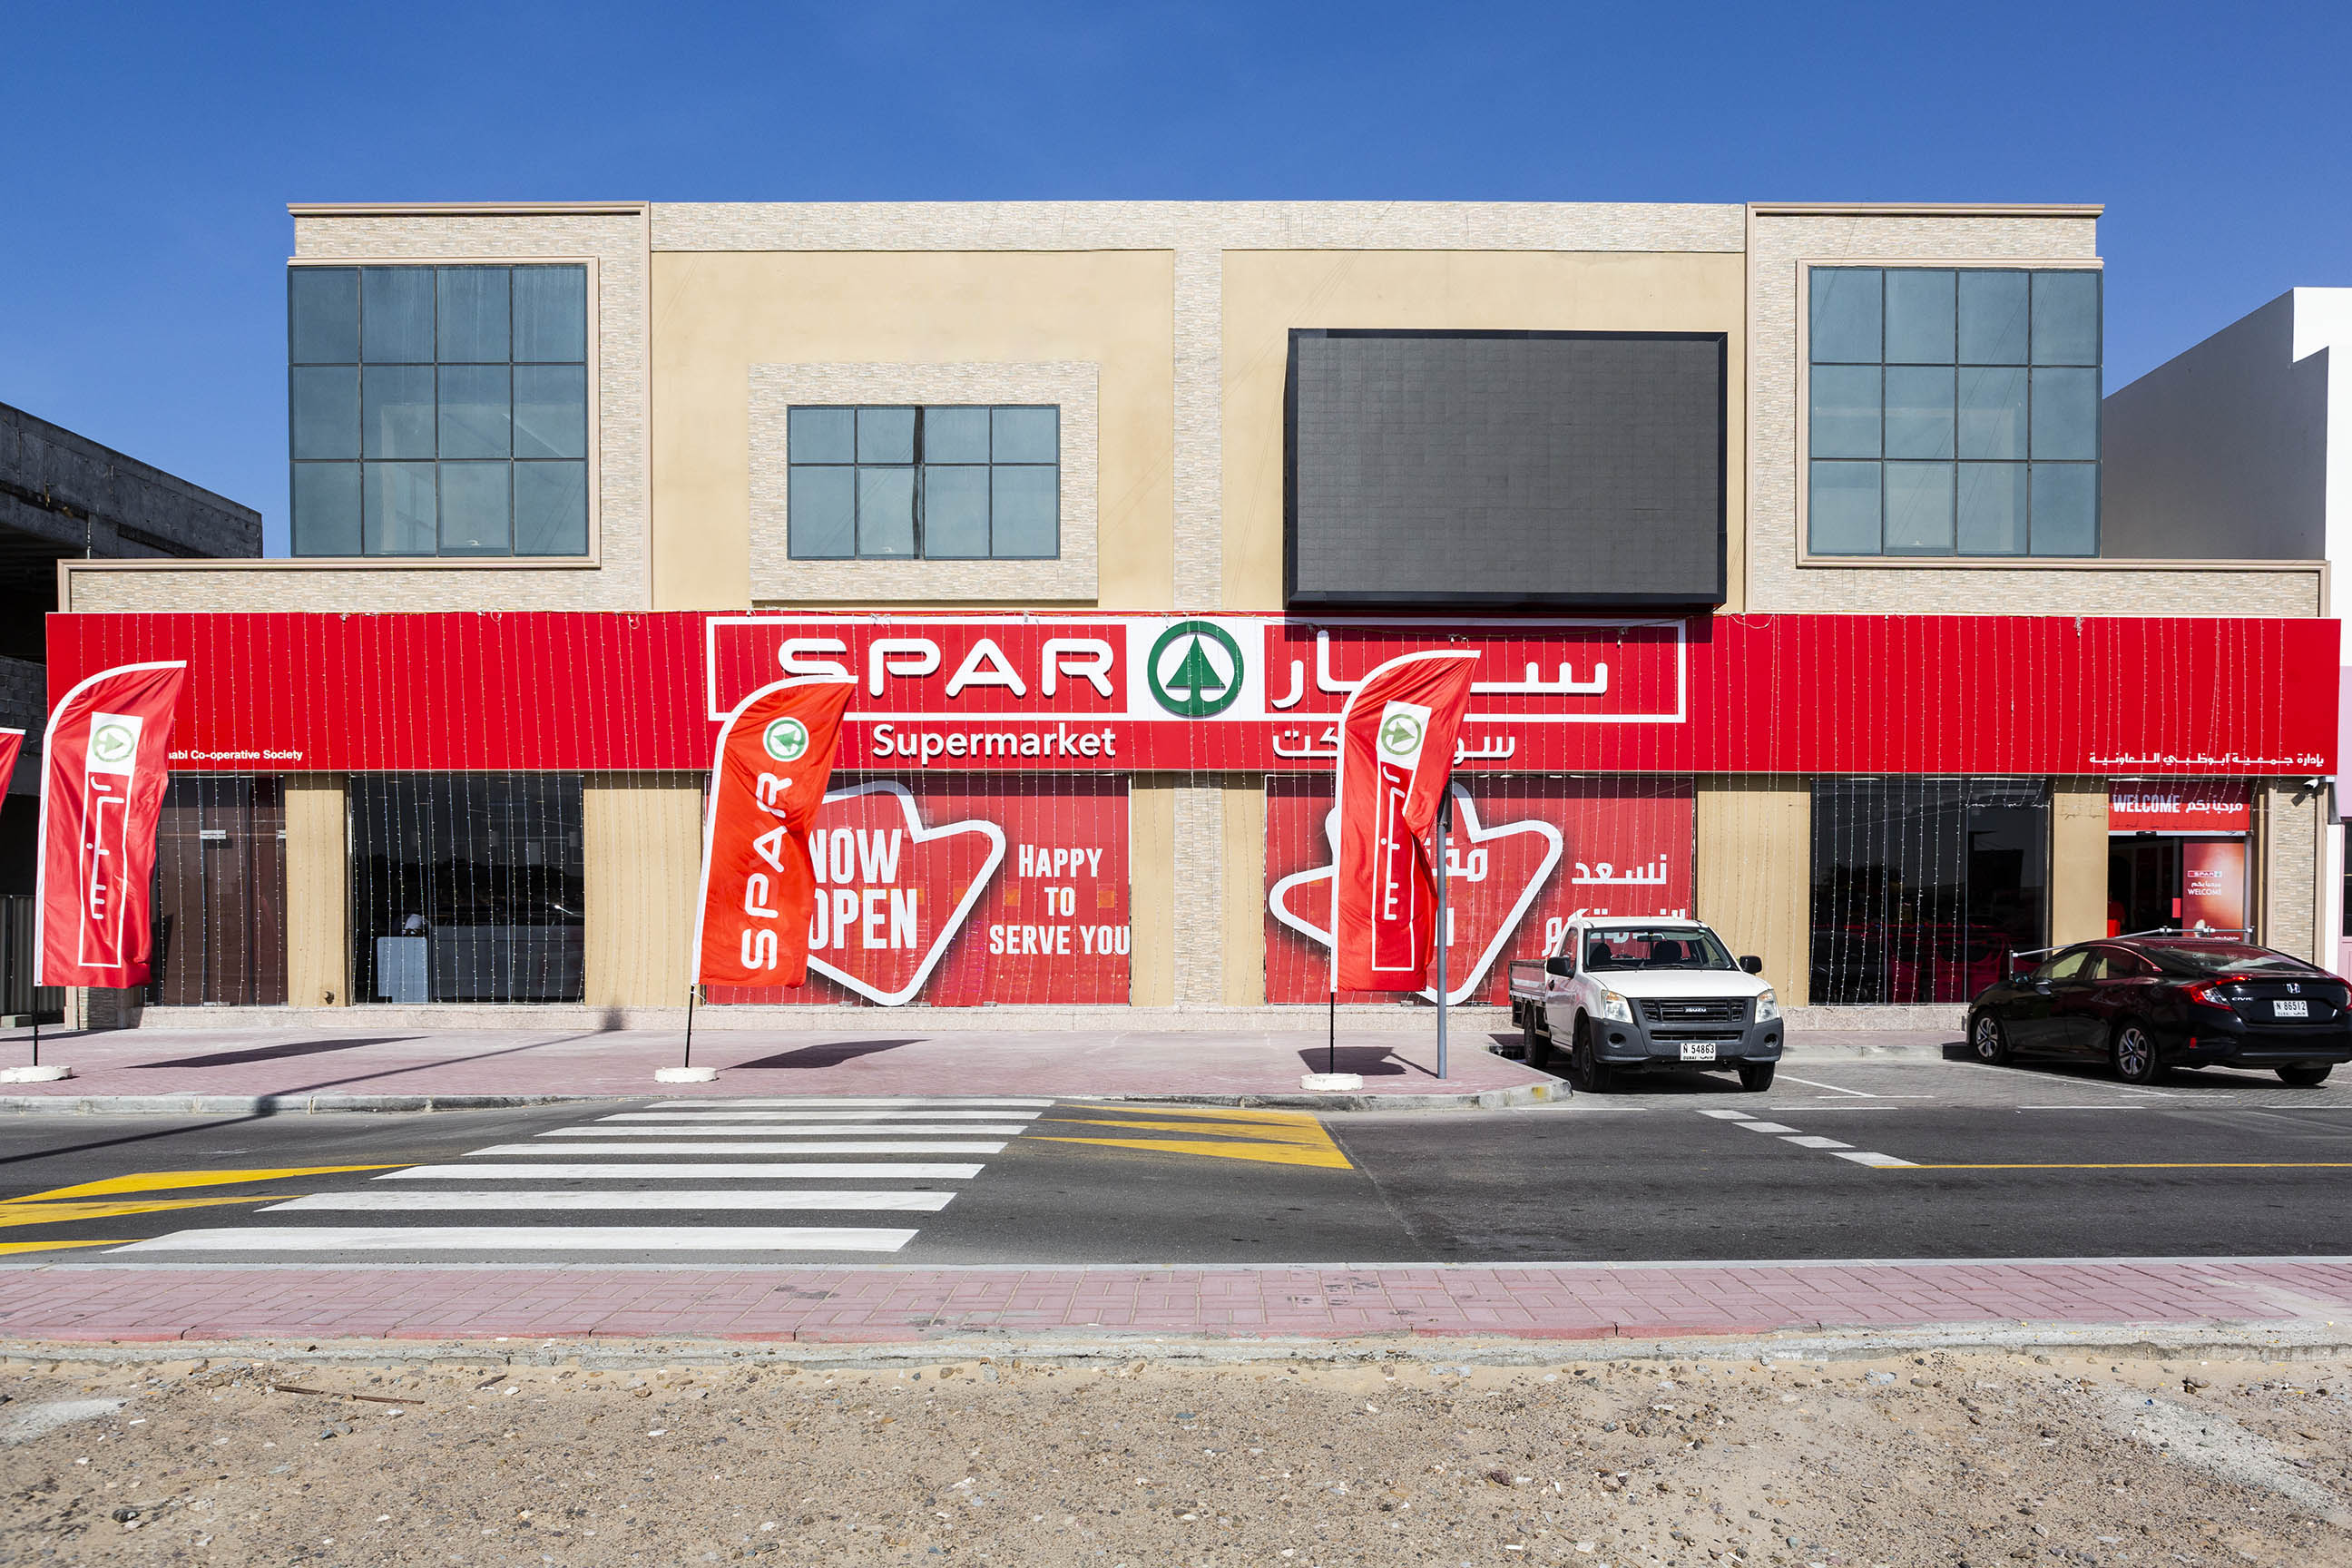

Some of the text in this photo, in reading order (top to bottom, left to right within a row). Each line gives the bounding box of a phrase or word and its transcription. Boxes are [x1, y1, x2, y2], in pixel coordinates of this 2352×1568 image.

[778, 638, 1115, 698] SPAR
[1270, 630, 1609, 710] سار
[190, 750, 260, 761] Co-operative
[262, 749, 303, 761] Society
[872, 722, 1117, 766] Supermarket
[2089, 752, 2161, 766] التعاونية
[2232, 752, 2294, 766] جمعية
[2112, 794, 2181, 814] WELCOME
[2185, 799, 2211, 814] بكم
[740, 772, 793, 971] SPAR
[1018, 844, 1103, 878] HAPPY
[1571, 853, 1668, 885] نسعد
[1044, 887, 1076, 916] TO
[989, 924, 1131, 956] SERVE YOU
[1691, 1044, 1715, 1054] 54863
